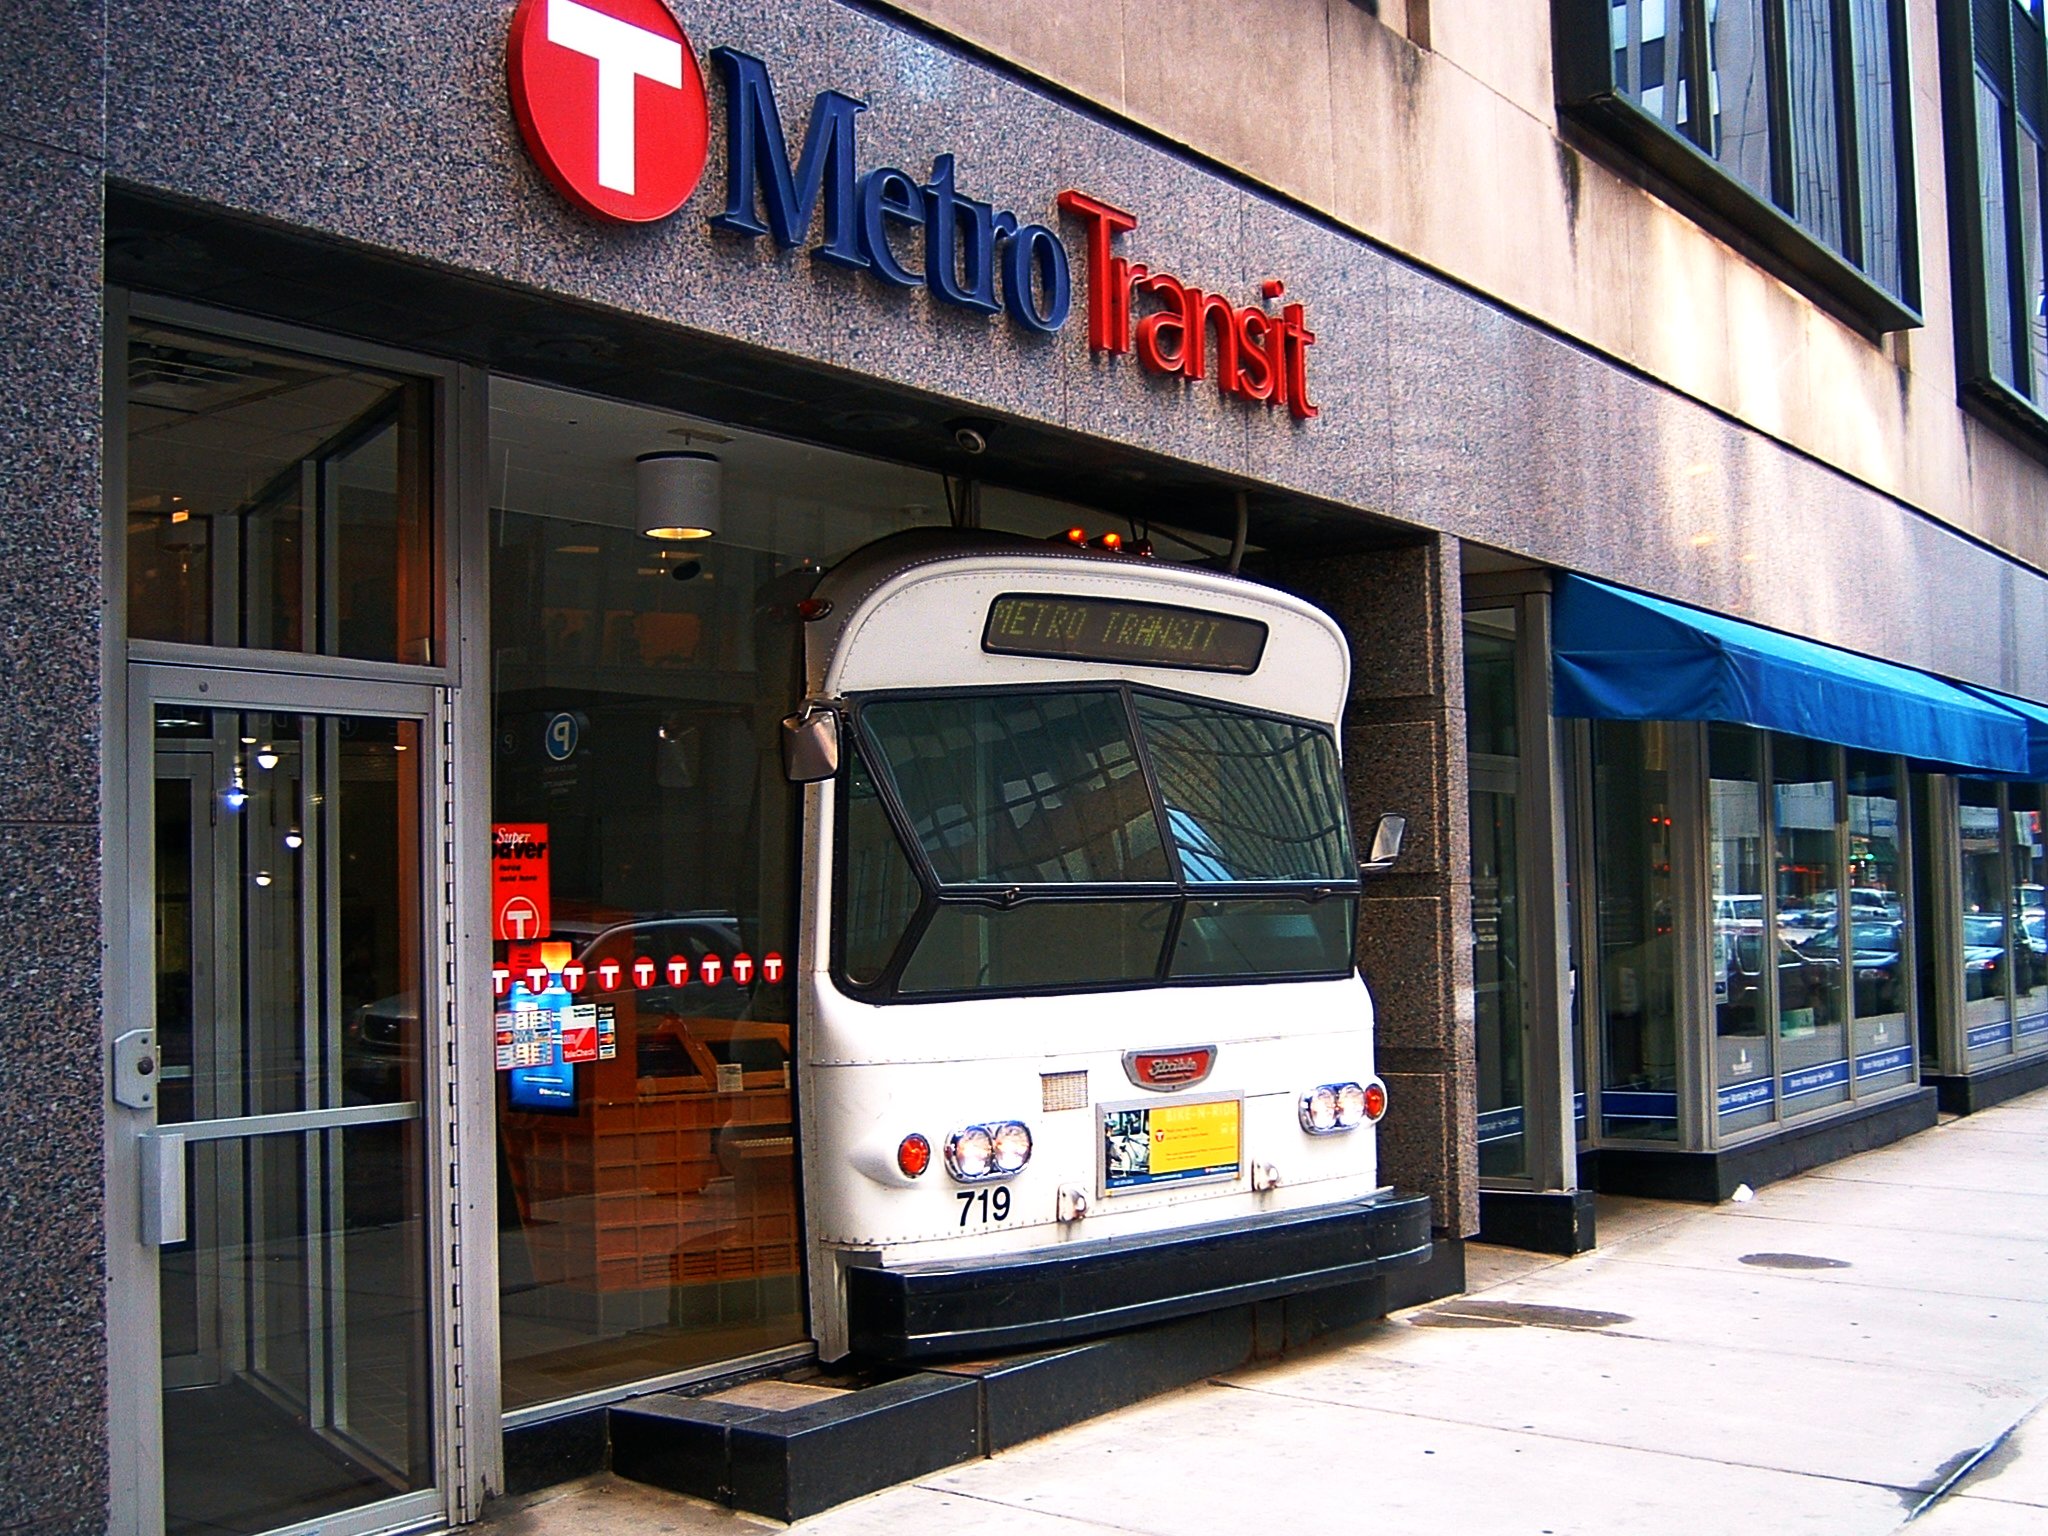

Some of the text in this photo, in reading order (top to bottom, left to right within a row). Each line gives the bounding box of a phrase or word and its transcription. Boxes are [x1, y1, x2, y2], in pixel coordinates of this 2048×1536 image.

[547, 0, 682, 195] T
[711, 45, 1318, 420] Metro Transit
[993, 600, 1220, 650] METRO TRANSIT
[497, 828, 531, 849] Super
[507, 909, 533, 940] T
[957, 1186, 1010, 1226] 719
